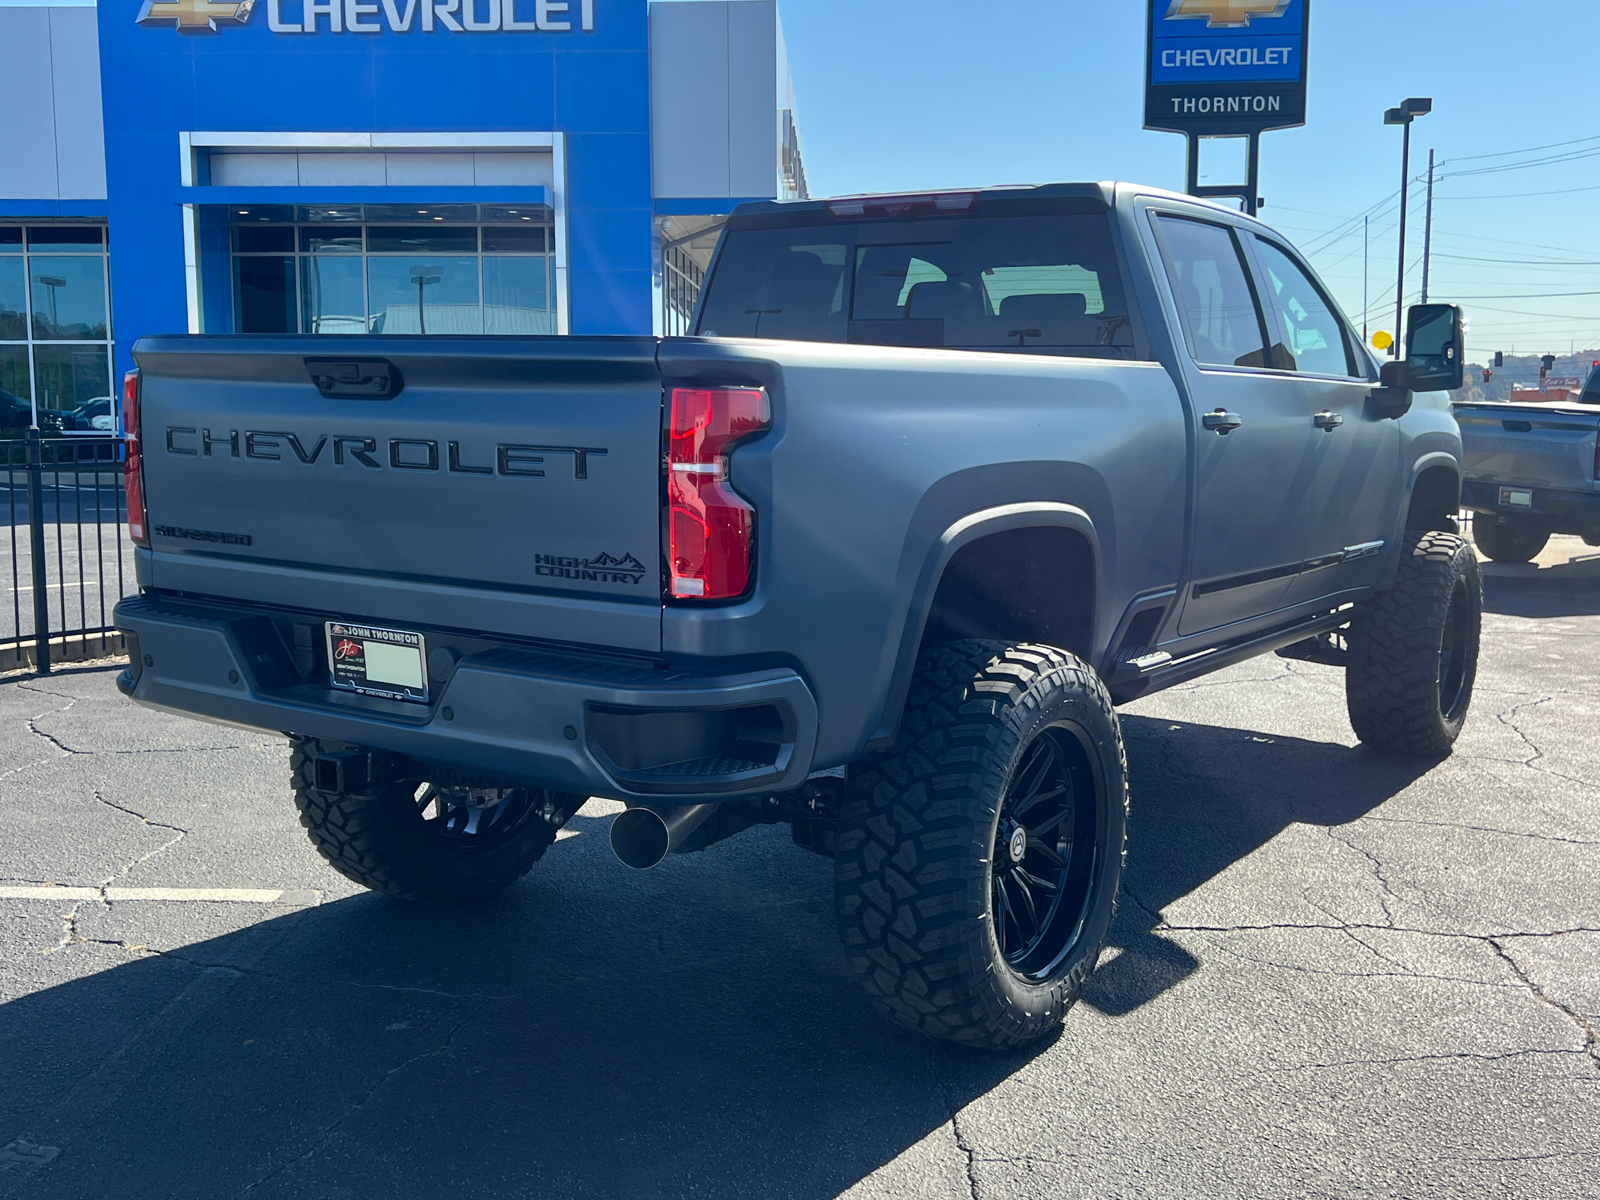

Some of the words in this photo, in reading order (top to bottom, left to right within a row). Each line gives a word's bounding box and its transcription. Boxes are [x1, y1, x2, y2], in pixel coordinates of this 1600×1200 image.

[1161, 47, 1293, 67] CHEVROLET
[1171, 96, 1280, 113] THORNTON
[166, 426, 608, 481] CHEVROLET
[534, 553, 589, 568] HIGH
[535, 565, 645, 584] COUNTRY
[349, 627, 370, 638] JOHN
[372, 629, 418, 644] THORNTON
[366, 690, 393, 699] CHEVROLET
